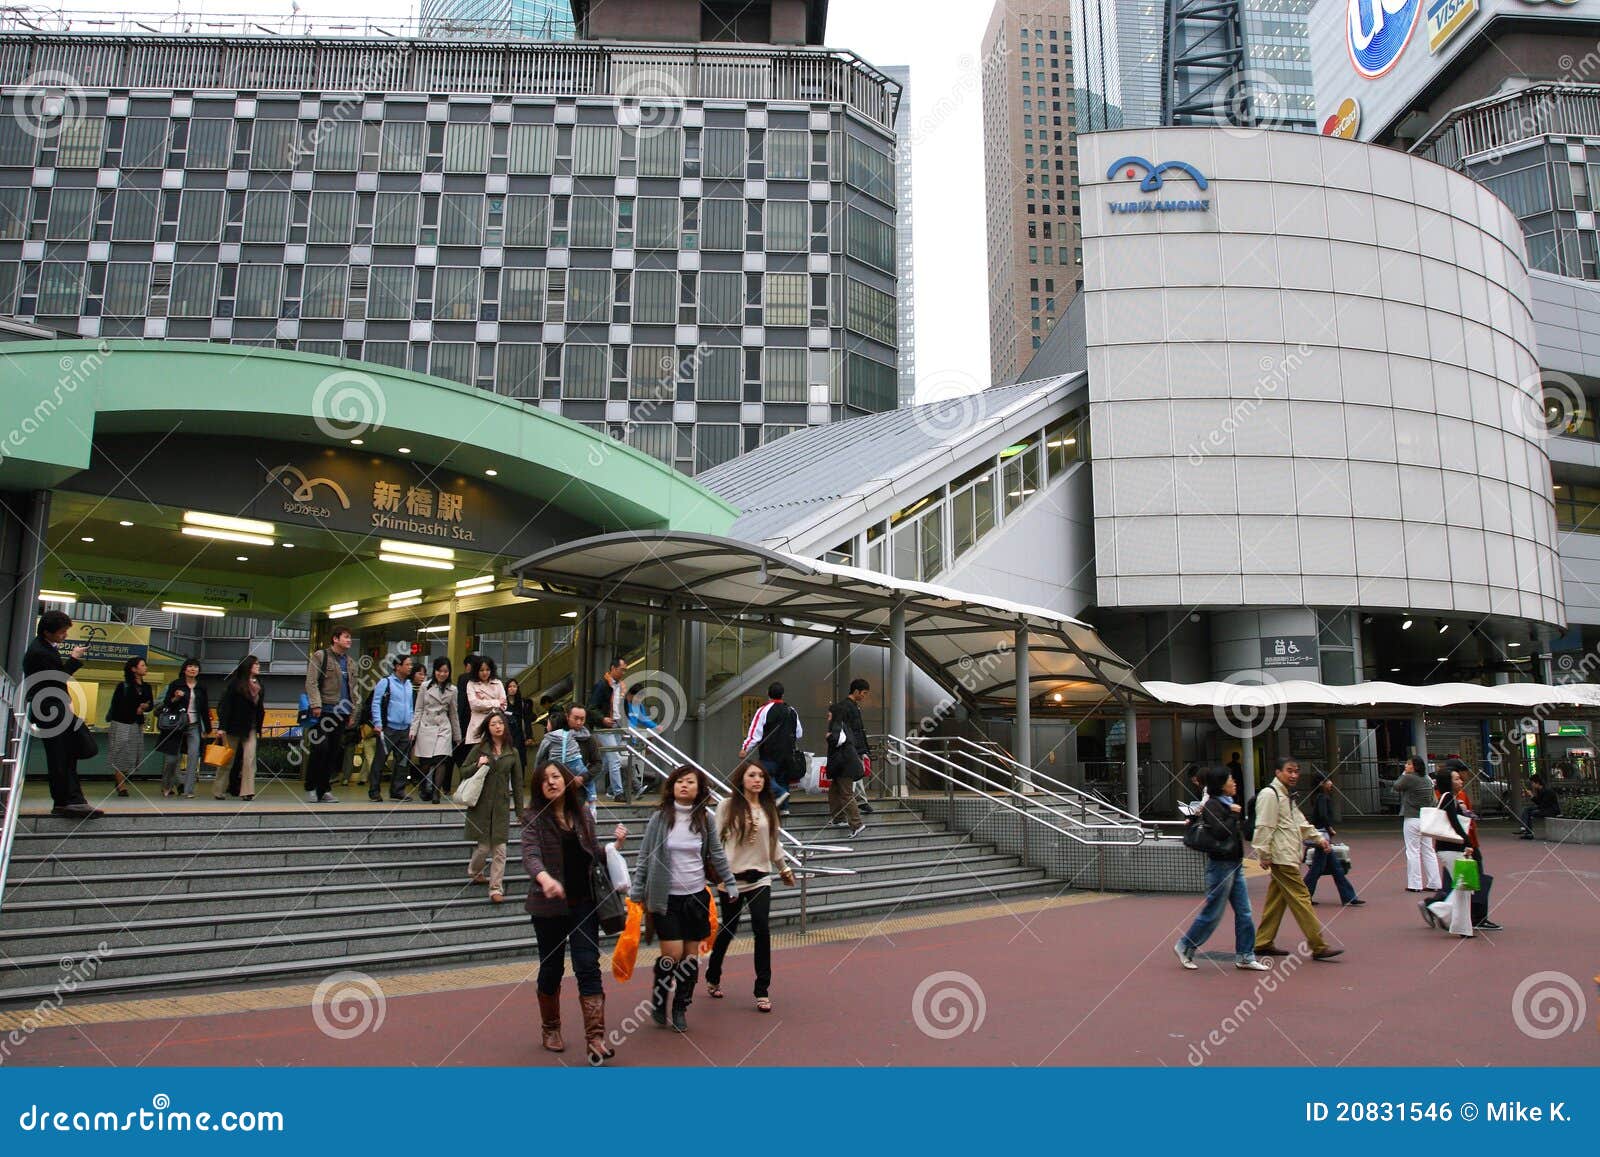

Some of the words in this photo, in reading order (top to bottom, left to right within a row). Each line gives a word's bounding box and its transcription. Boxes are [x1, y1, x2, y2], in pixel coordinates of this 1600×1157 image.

[373, 480, 463, 523] 新橋駅
[371, 513, 448, 537] Shimbashi
[451, 526, 476, 541] Sta.
